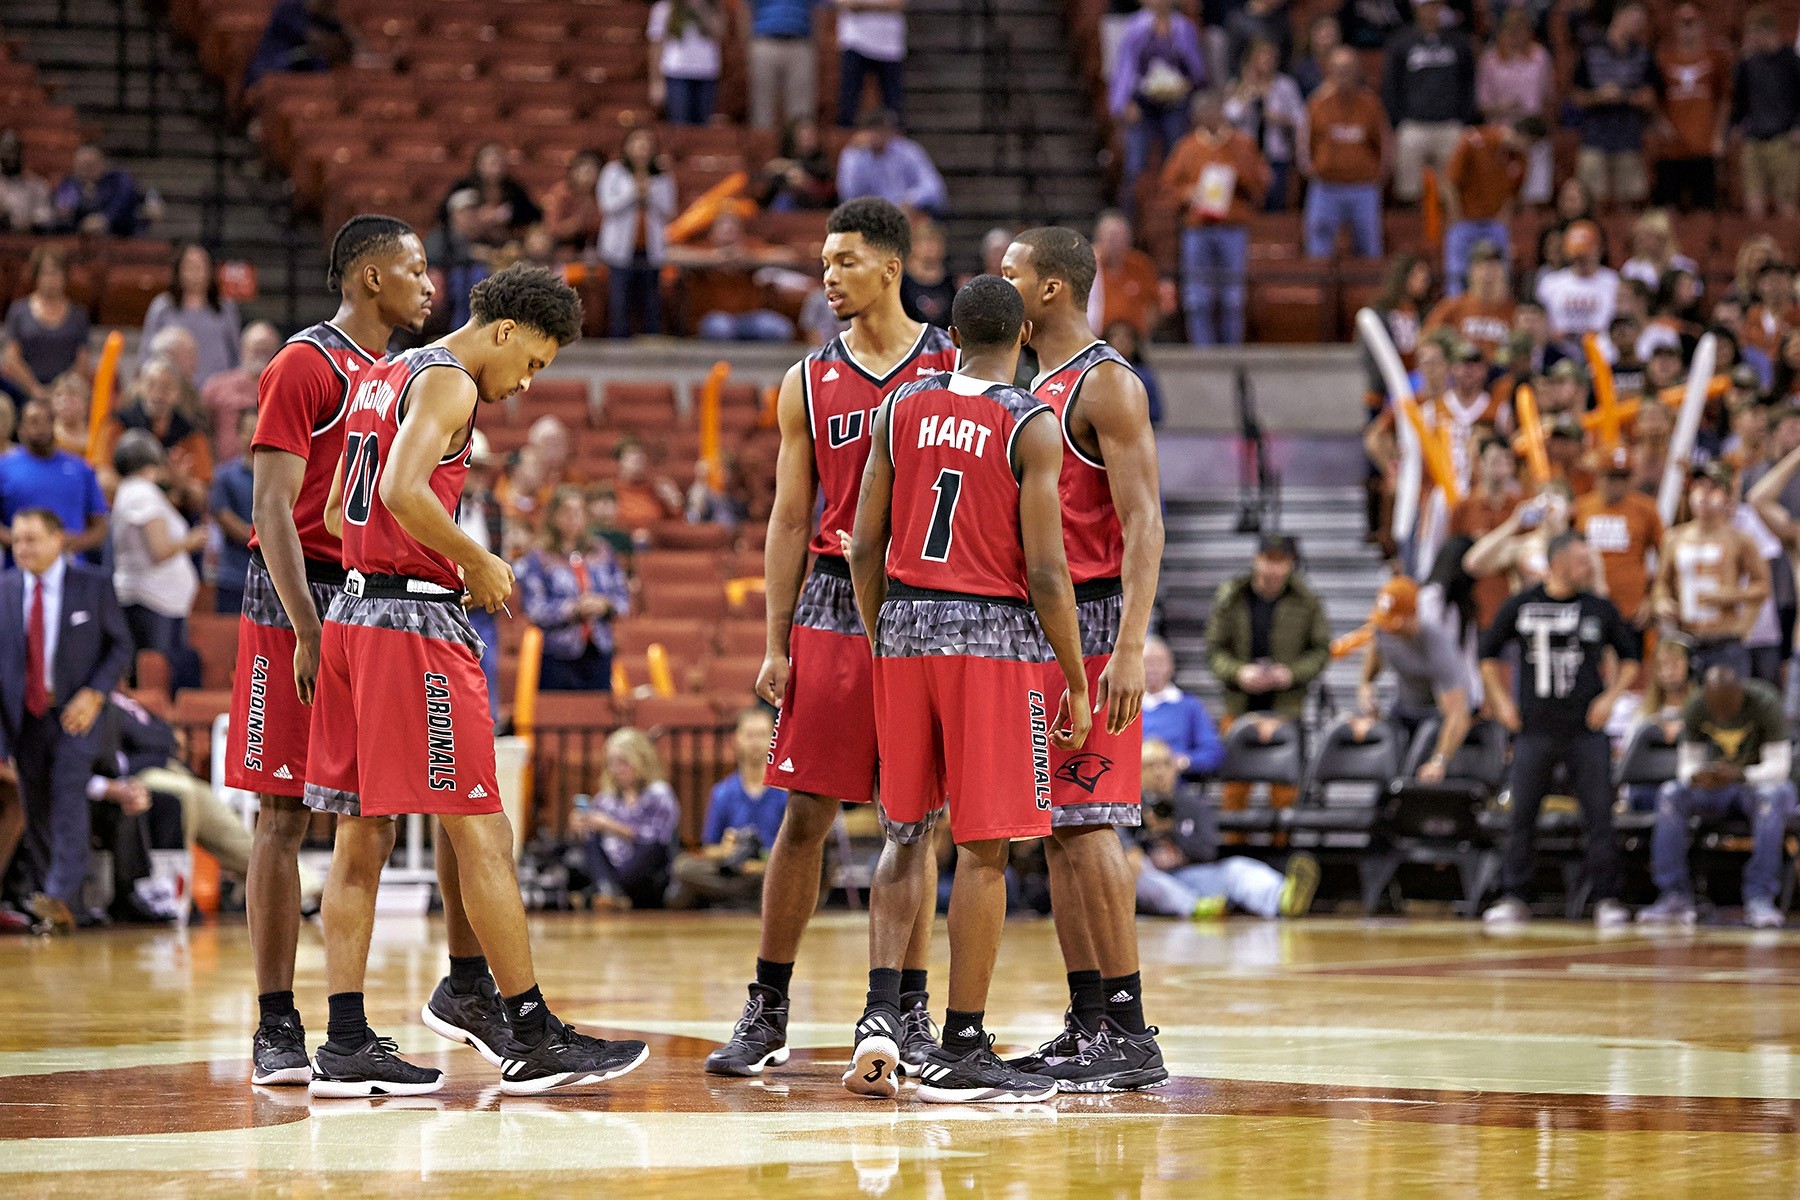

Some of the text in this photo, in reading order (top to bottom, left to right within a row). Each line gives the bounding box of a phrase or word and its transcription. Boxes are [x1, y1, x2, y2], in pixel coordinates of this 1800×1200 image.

[917, 415, 992, 458] HART
[920, 467, 964, 563] 1
[1676, 543, 1722, 624] E
[243, 654, 269, 772] CARDINALS
[424, 671, 457, 791] CARDINALS
[1028, 689, 1052, 811] CARDINALS
